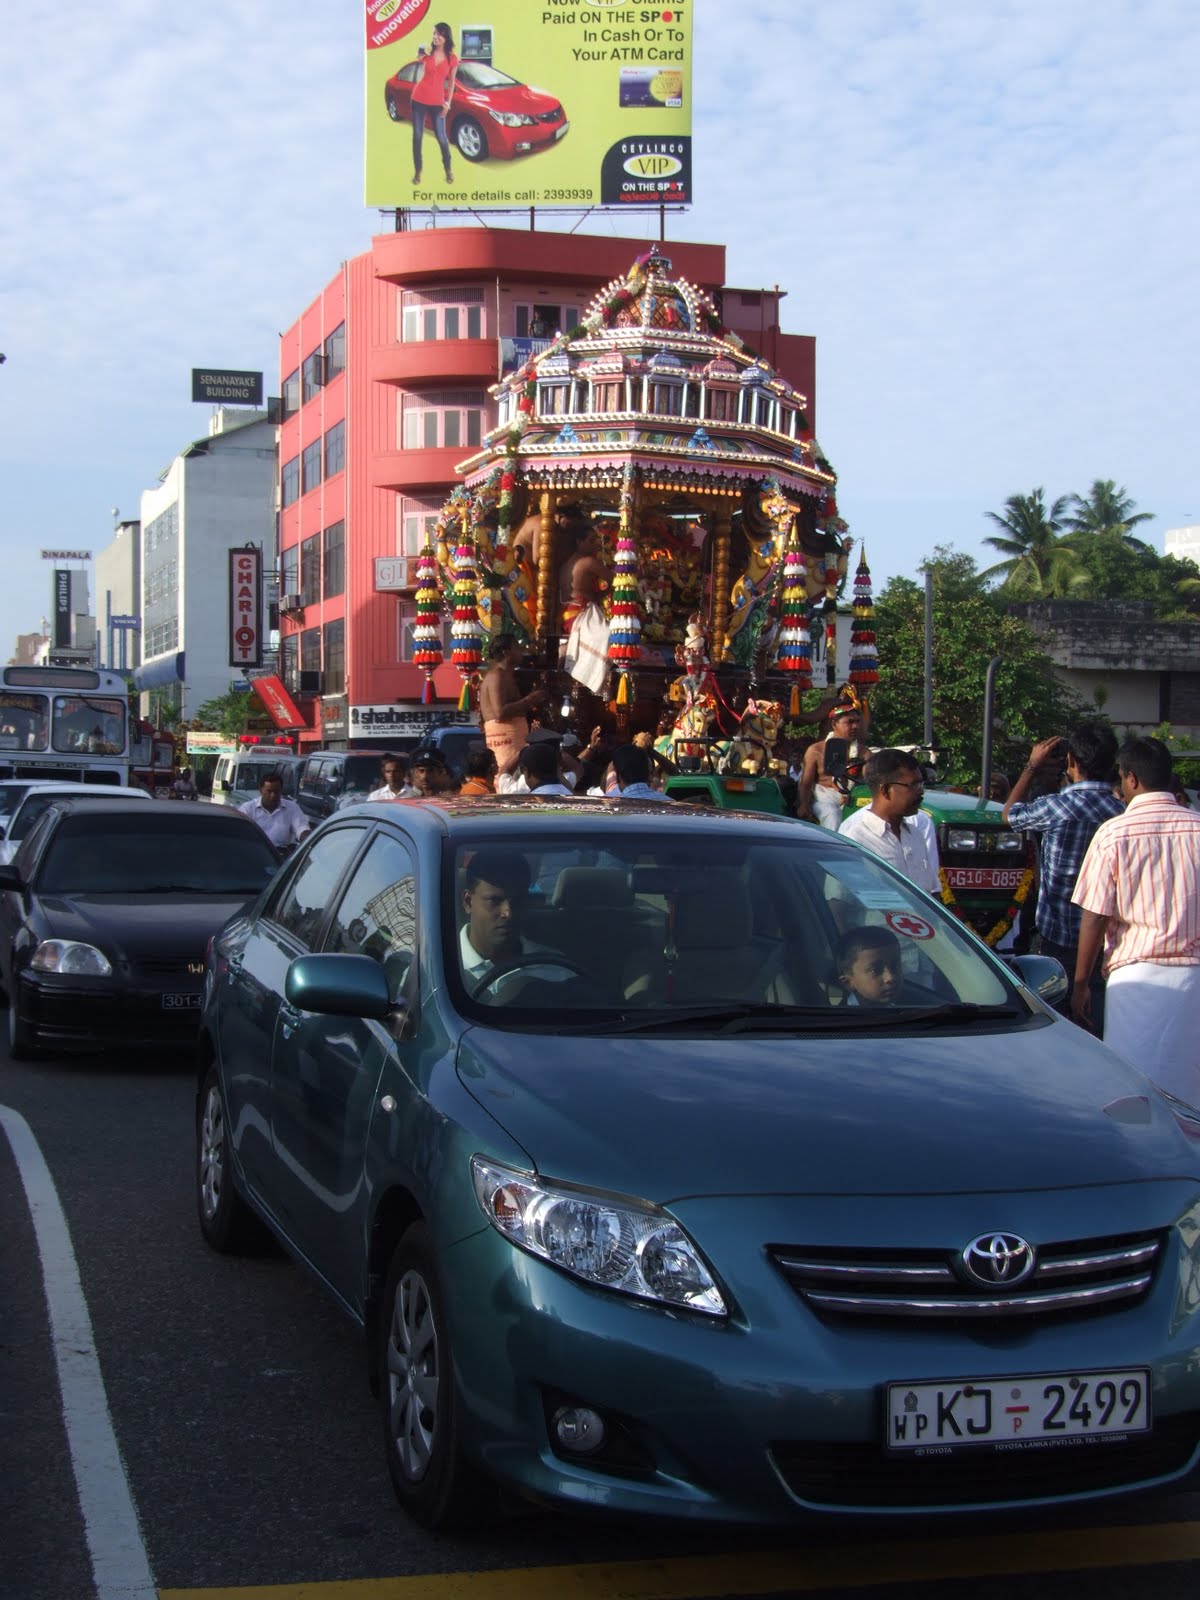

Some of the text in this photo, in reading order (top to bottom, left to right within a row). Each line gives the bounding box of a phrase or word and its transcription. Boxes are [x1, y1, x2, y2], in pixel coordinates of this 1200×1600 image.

[380, 1, 395, 16] VIP
[371, 0, 424, 46] Innovatio
[542, 12, 576, 24] Paid
[580, 11, 601, 24] ON
[607, 11, 635, 23] THE
[584, 28, 685, 42] In Cash Or To
[572, 47, 684, 61] Your ATM Card
[622, 144, 683, 153] CEYLINCO
[638, 158, 669, 175] VIP
[622, 182, 636, 192] ON
[638, 182, 655, 192] THE
[412, 189, 593, 200] For more details call: 2393939
[200, 375, 255, 386] SENANAYAKE
[206, 387, 249, 397] BUILDING
[42, 551, 91, 559] DINAPALA
[58, 573, 68, 613] PHILIPS
[235, 557, 255, 659] CHARIOT
[936, 1388, 992, 1438] KJ
[1042, 1378, 1142, 1431] 2499
[925, 1447, 952, 1455] TOYOTA
[994, 1443, 1023, 1451] TOYOTA
[1023, 1441, 1049, 1449] LANKA
